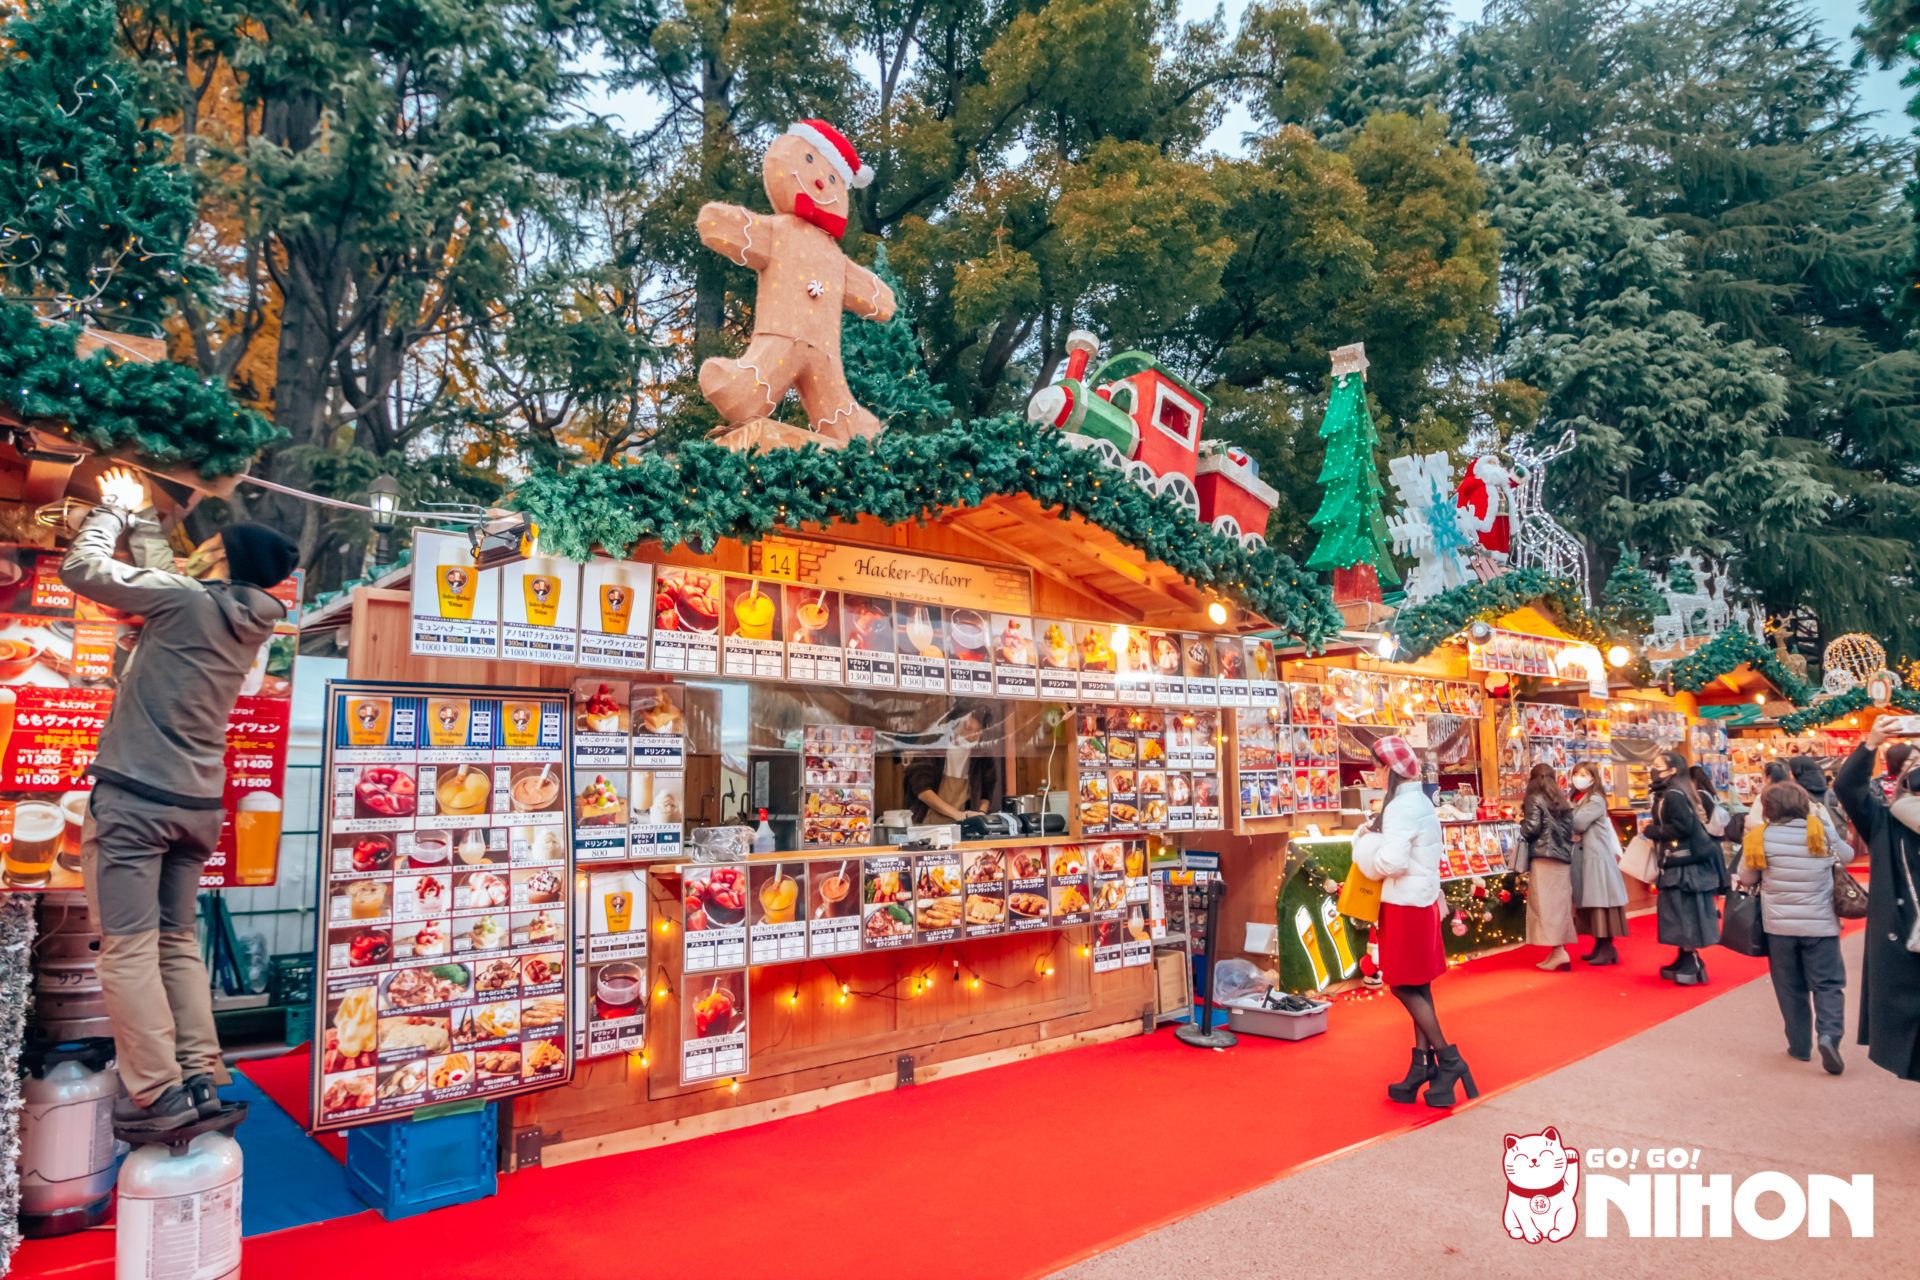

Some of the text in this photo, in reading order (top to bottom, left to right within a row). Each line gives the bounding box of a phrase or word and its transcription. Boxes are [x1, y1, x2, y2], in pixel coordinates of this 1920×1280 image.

[770, 554, 791, 575] 14
[854, 556, 972, 589] Hacker-Pschorr
[416, 622, 495, 634] ミュンヘナーゴールド
[76, 666, 108, 675] ¥700
[850, 672, 869, 681] 1300
[17, 754, 61, 764] ¥1200
[234, 759, 273, 769] ¥1400
[16, 774, 60, 785] ¥1500
[232, 778, 271, 788] ¥1500
[634, 846, 653, 854] 1200
[58, 974, 98, 985] サワー
